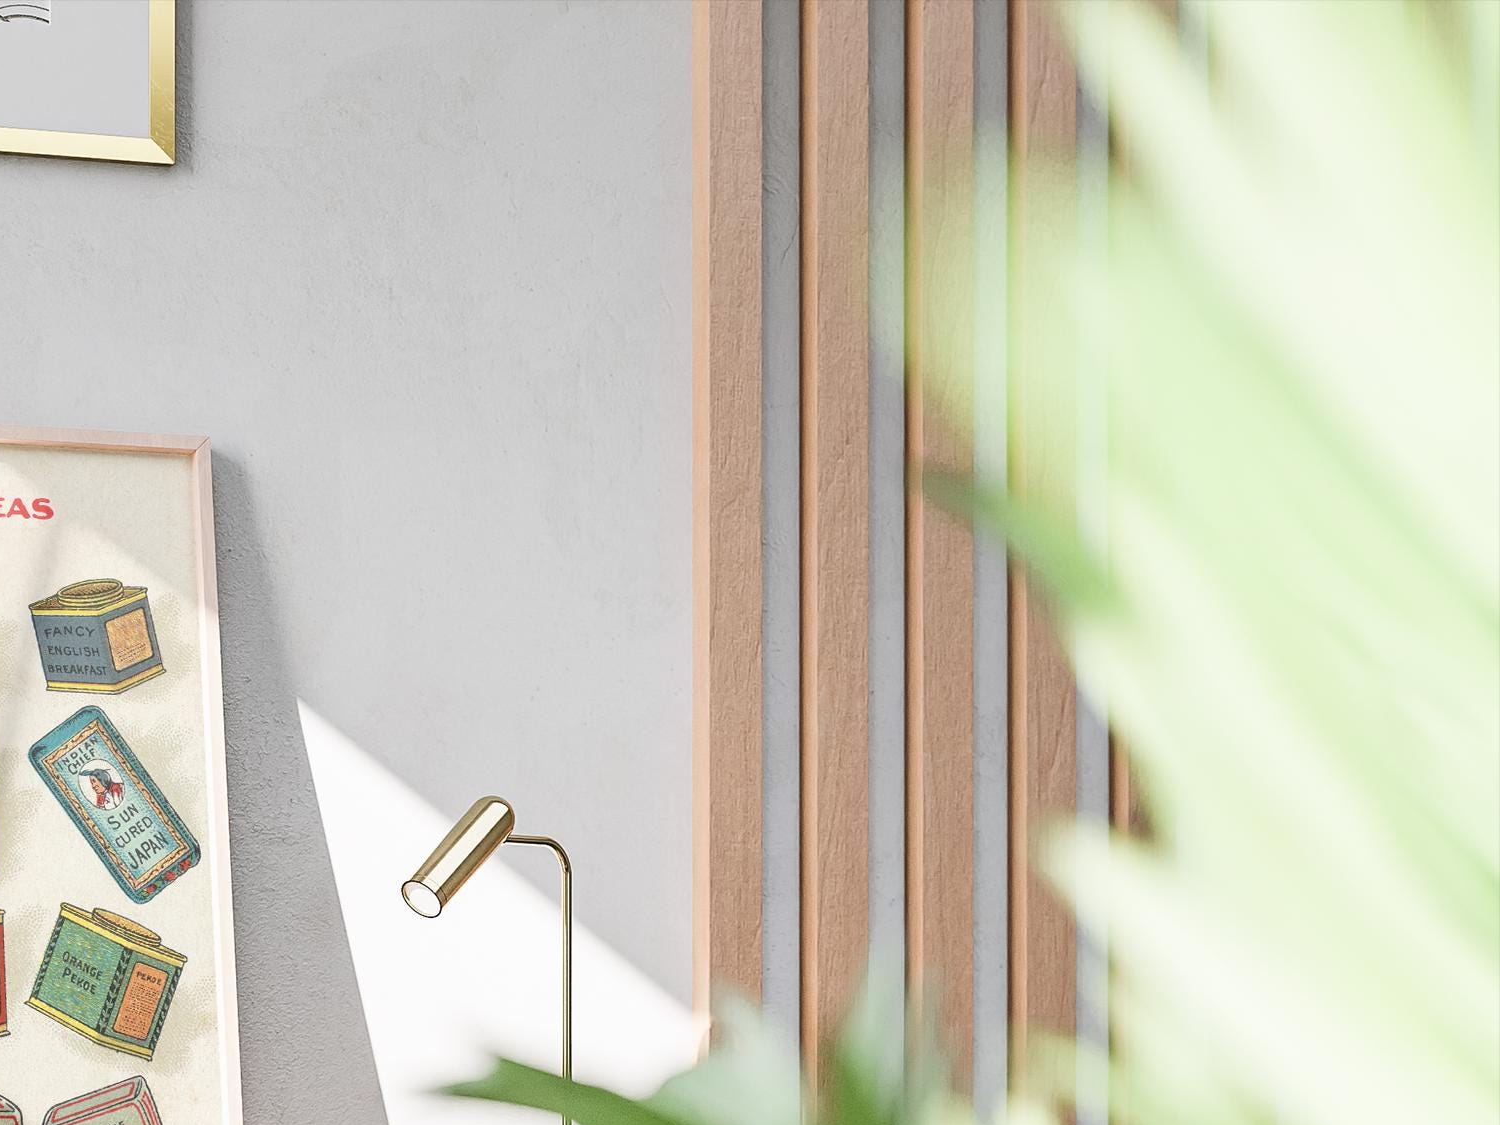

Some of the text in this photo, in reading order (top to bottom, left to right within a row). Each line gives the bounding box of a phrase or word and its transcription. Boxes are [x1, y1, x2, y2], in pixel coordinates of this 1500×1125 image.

[44, 626, 95, 638] FANCY
[48, 646, 100, 656] ENGLISH
[48, 665, 107, 675] BREAKFAST
[57, 737, 99, 770] INDIAN
[68, 748, 96, 775] CHIEF
[107, 803, 139, 830] SUN
[116, 817, 153, 848] CURED
[130, 832, 169, 869] JAPAN
[62, 951, 103, 980] ORANGE
[136, 972, 162, 985] PEKOE
[62, 968, 97, 994] PEKOE
